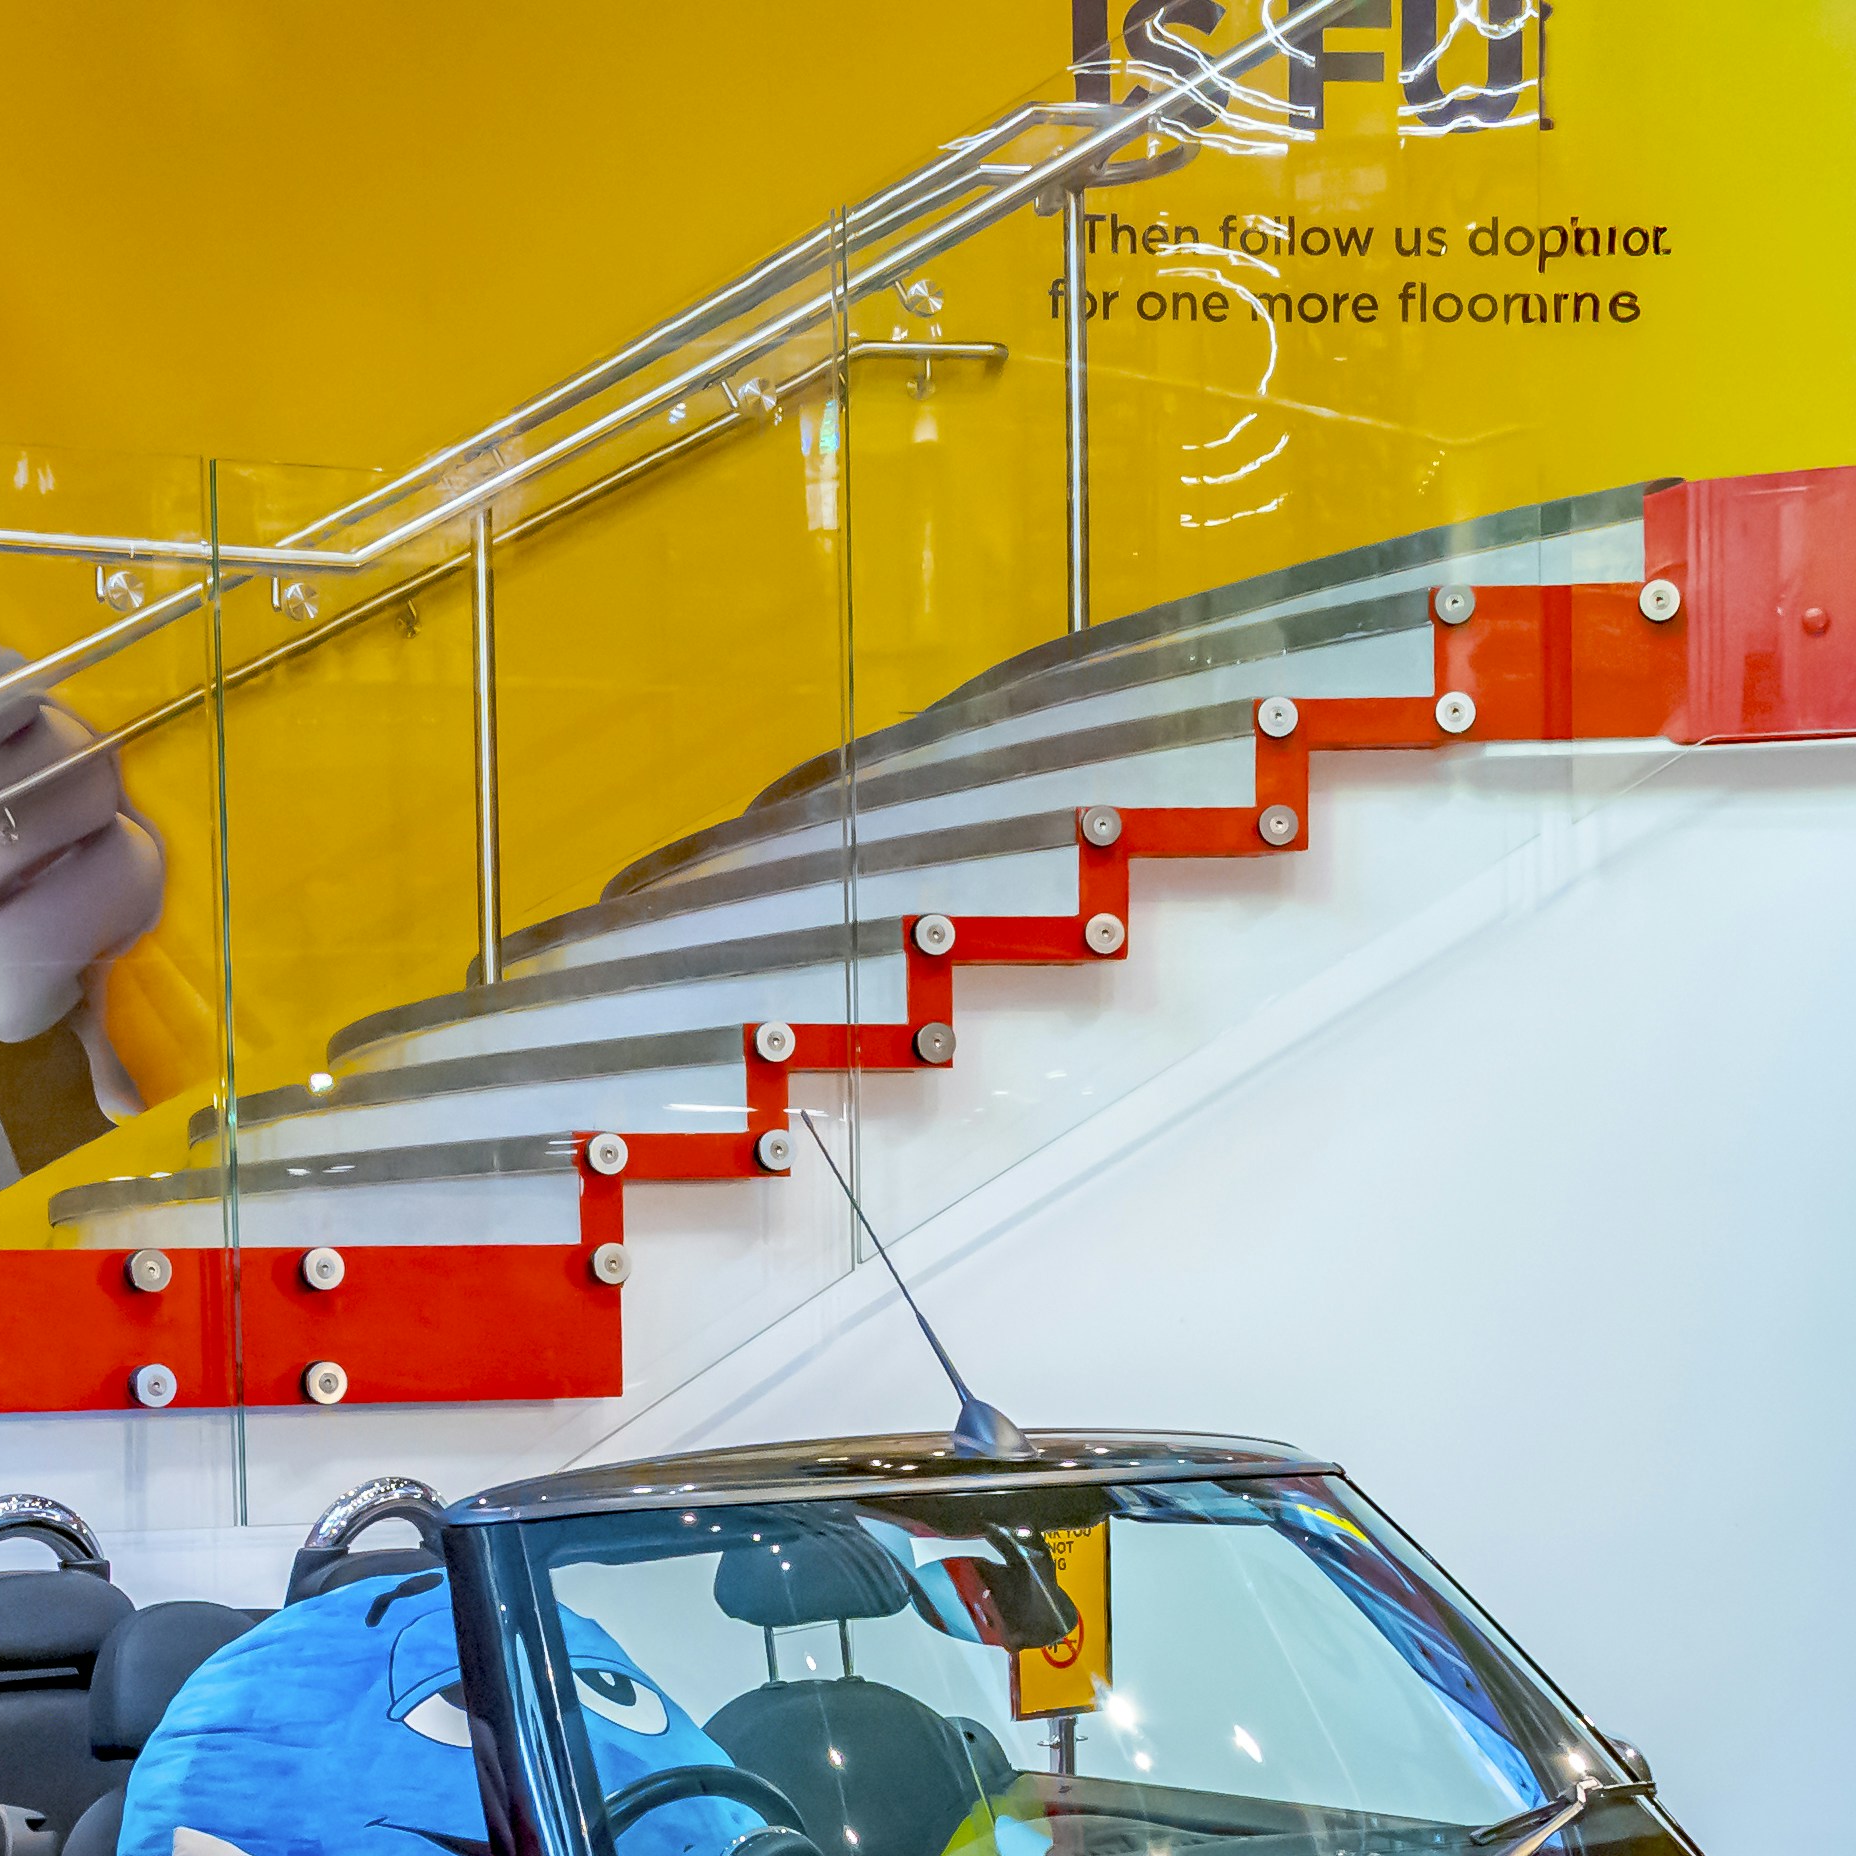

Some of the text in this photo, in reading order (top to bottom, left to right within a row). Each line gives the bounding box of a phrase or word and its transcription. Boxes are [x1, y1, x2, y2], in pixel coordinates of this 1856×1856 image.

[1083, 213, 1200, 255] Then
[1218, 214, 1374, 257] follow
[1394, 226, 1448, 257] us
[1136, 291, 1229, 322] one
[1249, 291, 1380, 323] more
